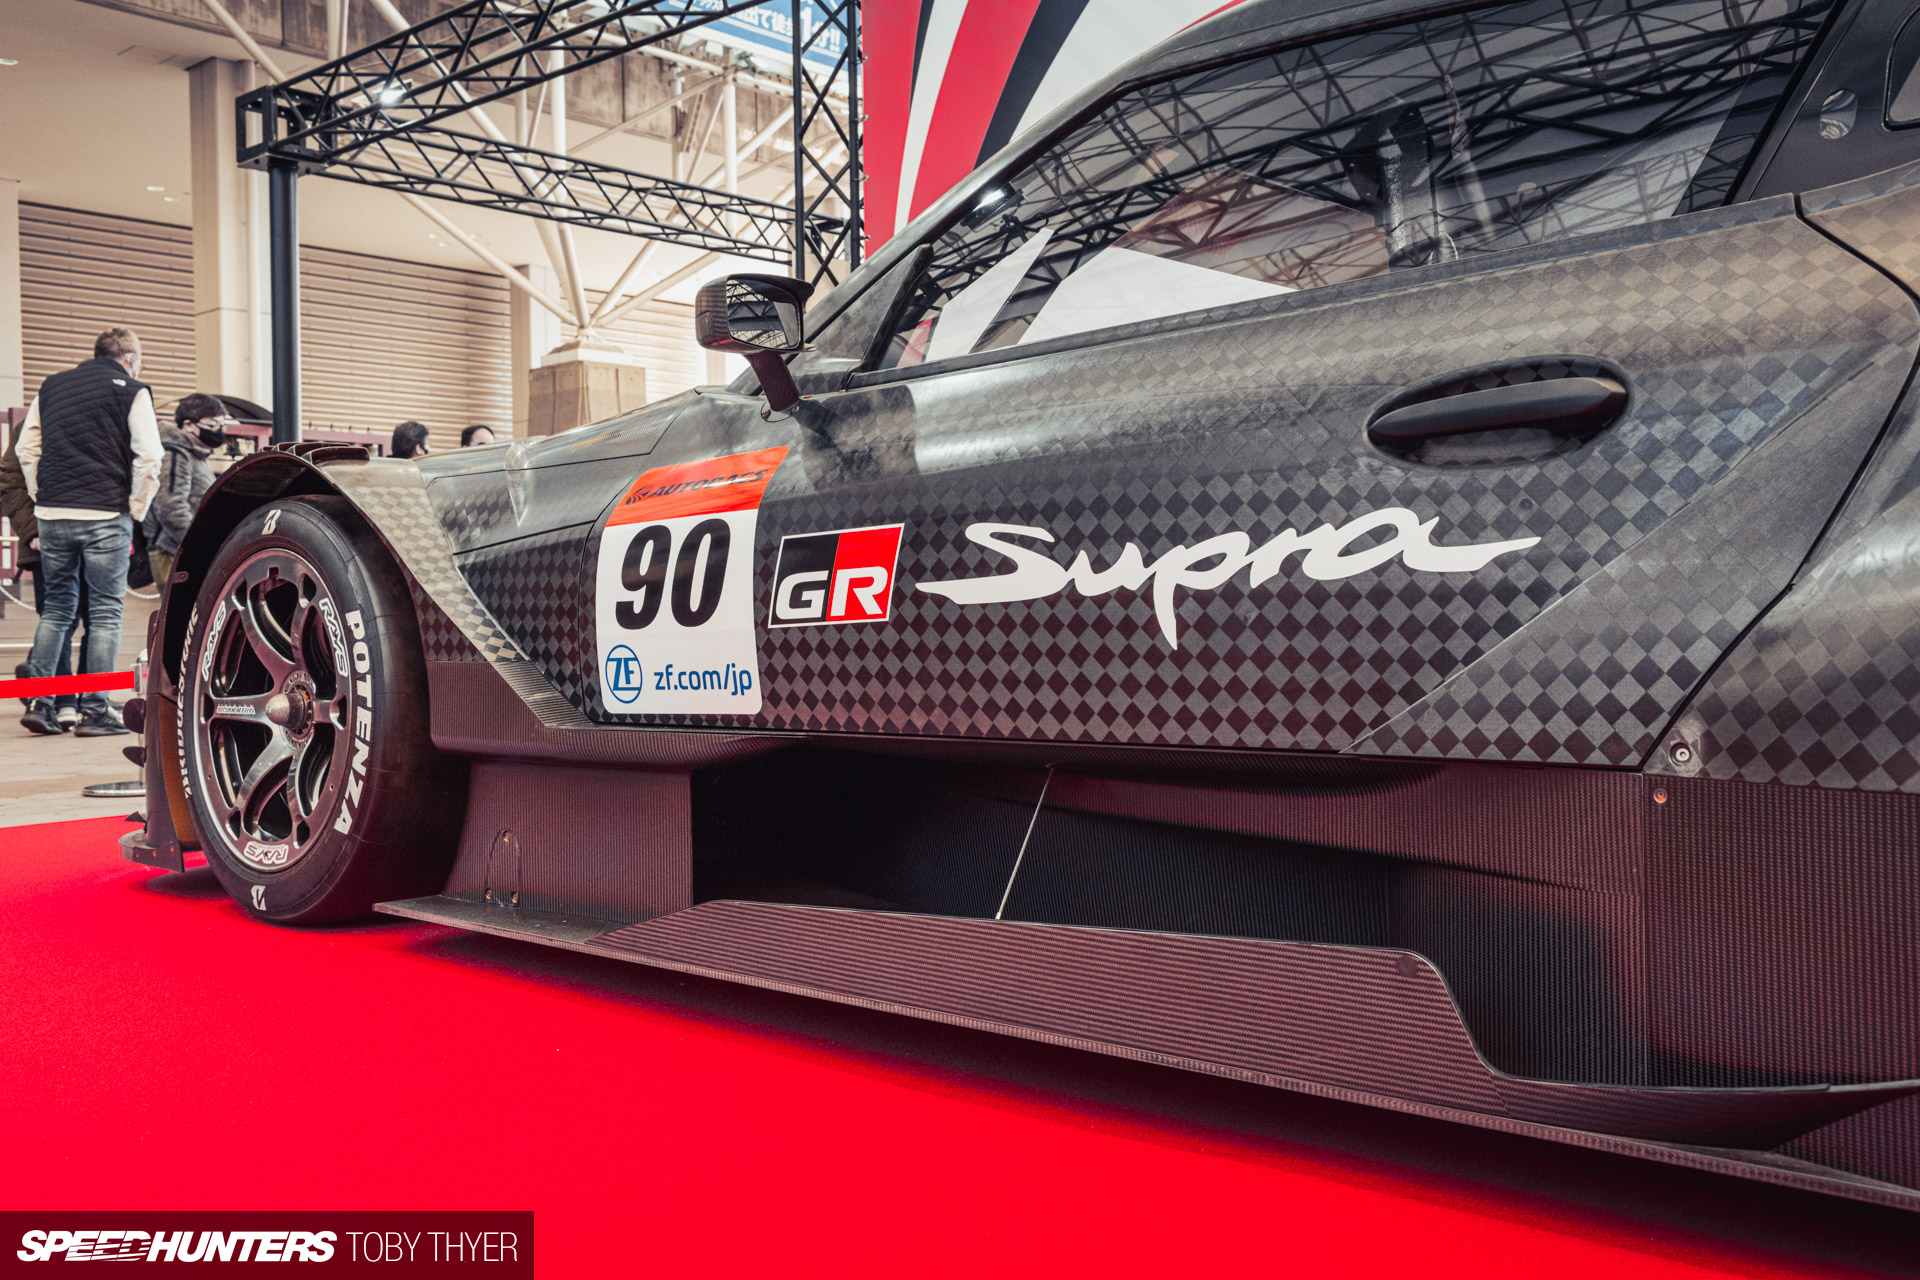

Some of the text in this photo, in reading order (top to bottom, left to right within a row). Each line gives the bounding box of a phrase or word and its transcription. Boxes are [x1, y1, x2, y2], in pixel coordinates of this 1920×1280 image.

[648, 469, 769, 498] AUTOBACS
[615, 518, 731, 630] 90
[775, 566, 889, 620] GR
[915, 507, 1542, 650] Supra
[202, 600, 226, 682] RAYS
[319, 598, 348, 677] RAYS
[606, 655, 641, 693] ZF
[653, 662, 753, 696] zf.com/jp
[333, 609, 373, 835] POTENZA
[244, 841, 289, 865] RAYS
